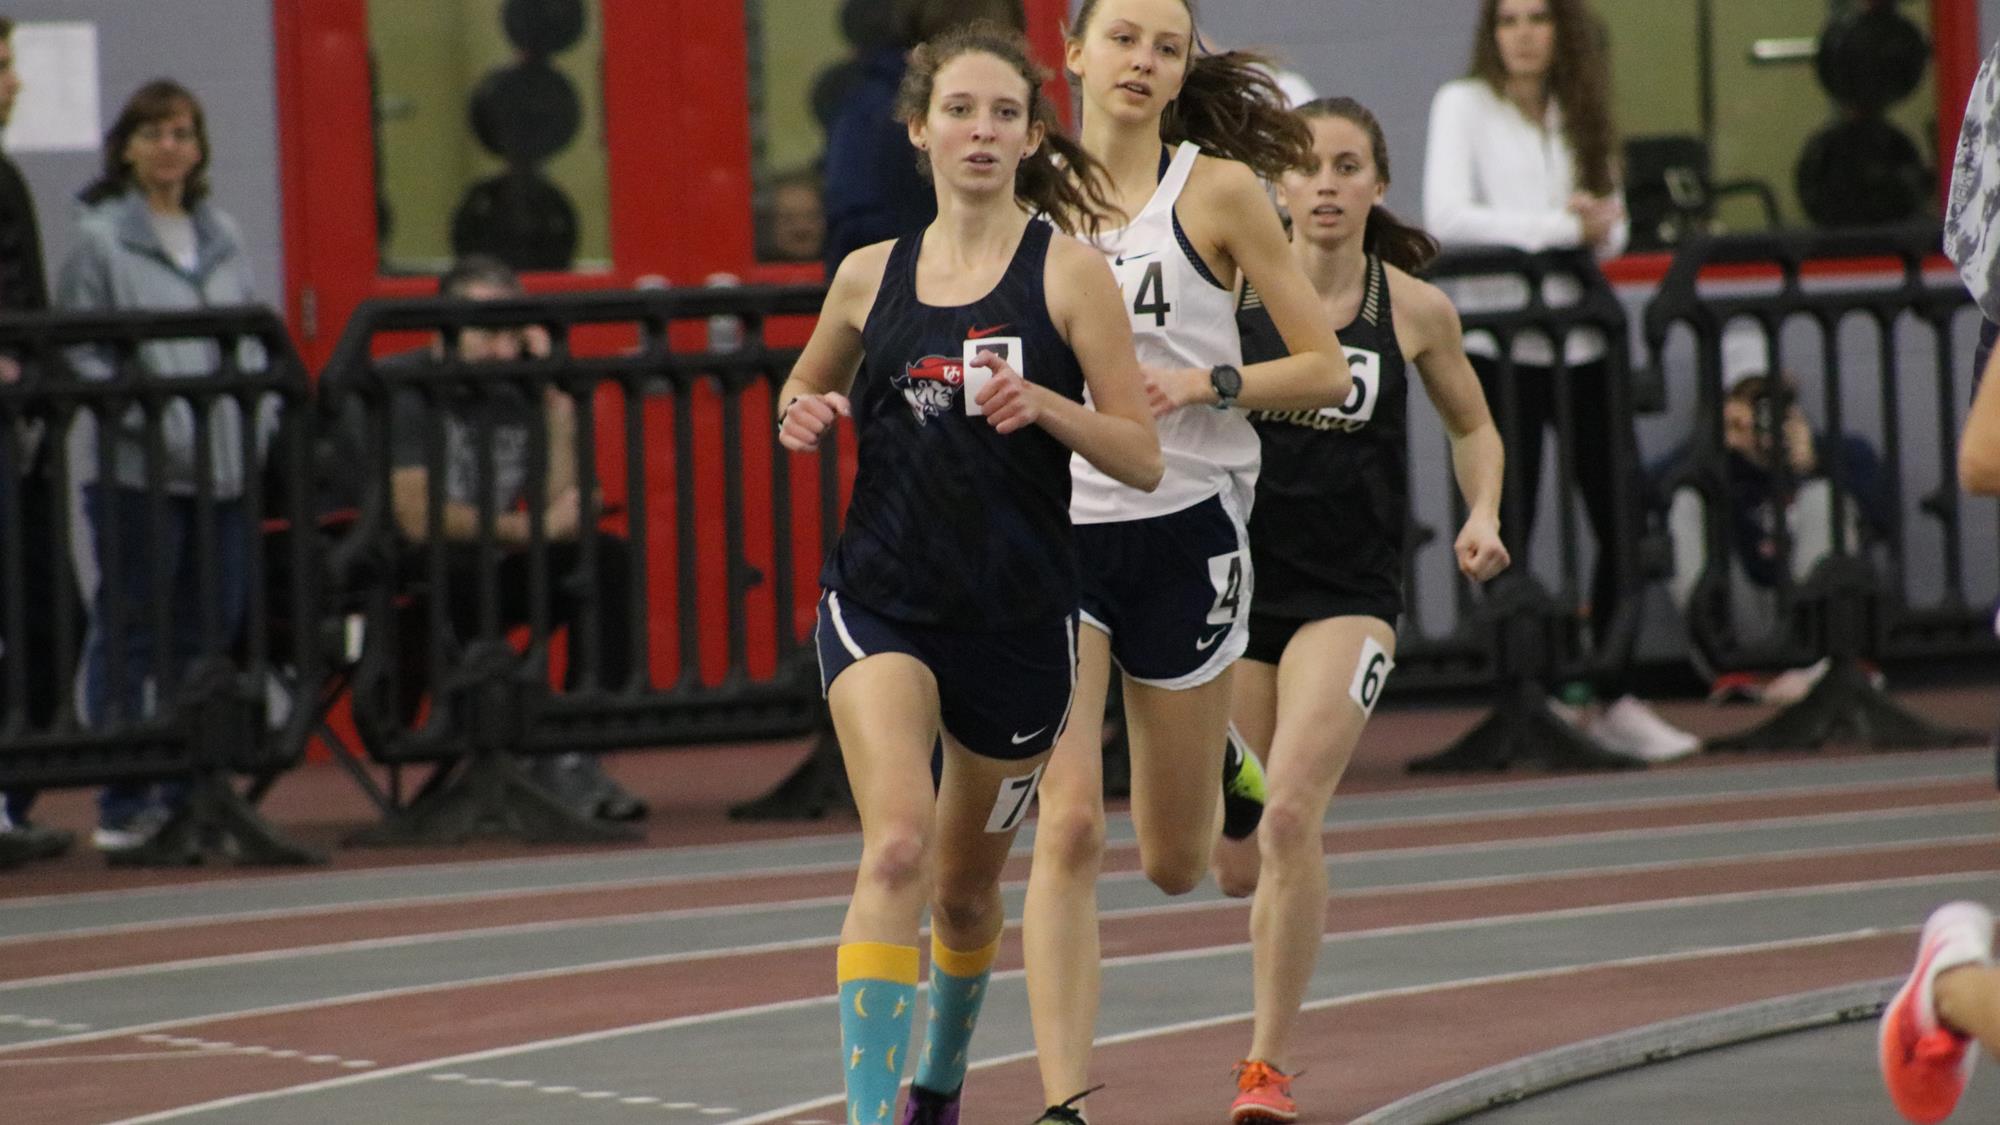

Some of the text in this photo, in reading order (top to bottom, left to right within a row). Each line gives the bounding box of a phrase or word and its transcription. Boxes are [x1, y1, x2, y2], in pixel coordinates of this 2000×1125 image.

[1133, 261, 1171, 327] 4
[1219, 556, 1242, 618] 4
[1361, 652, 1385, 707] 6
[1001, 774, 1035, 829] 7
